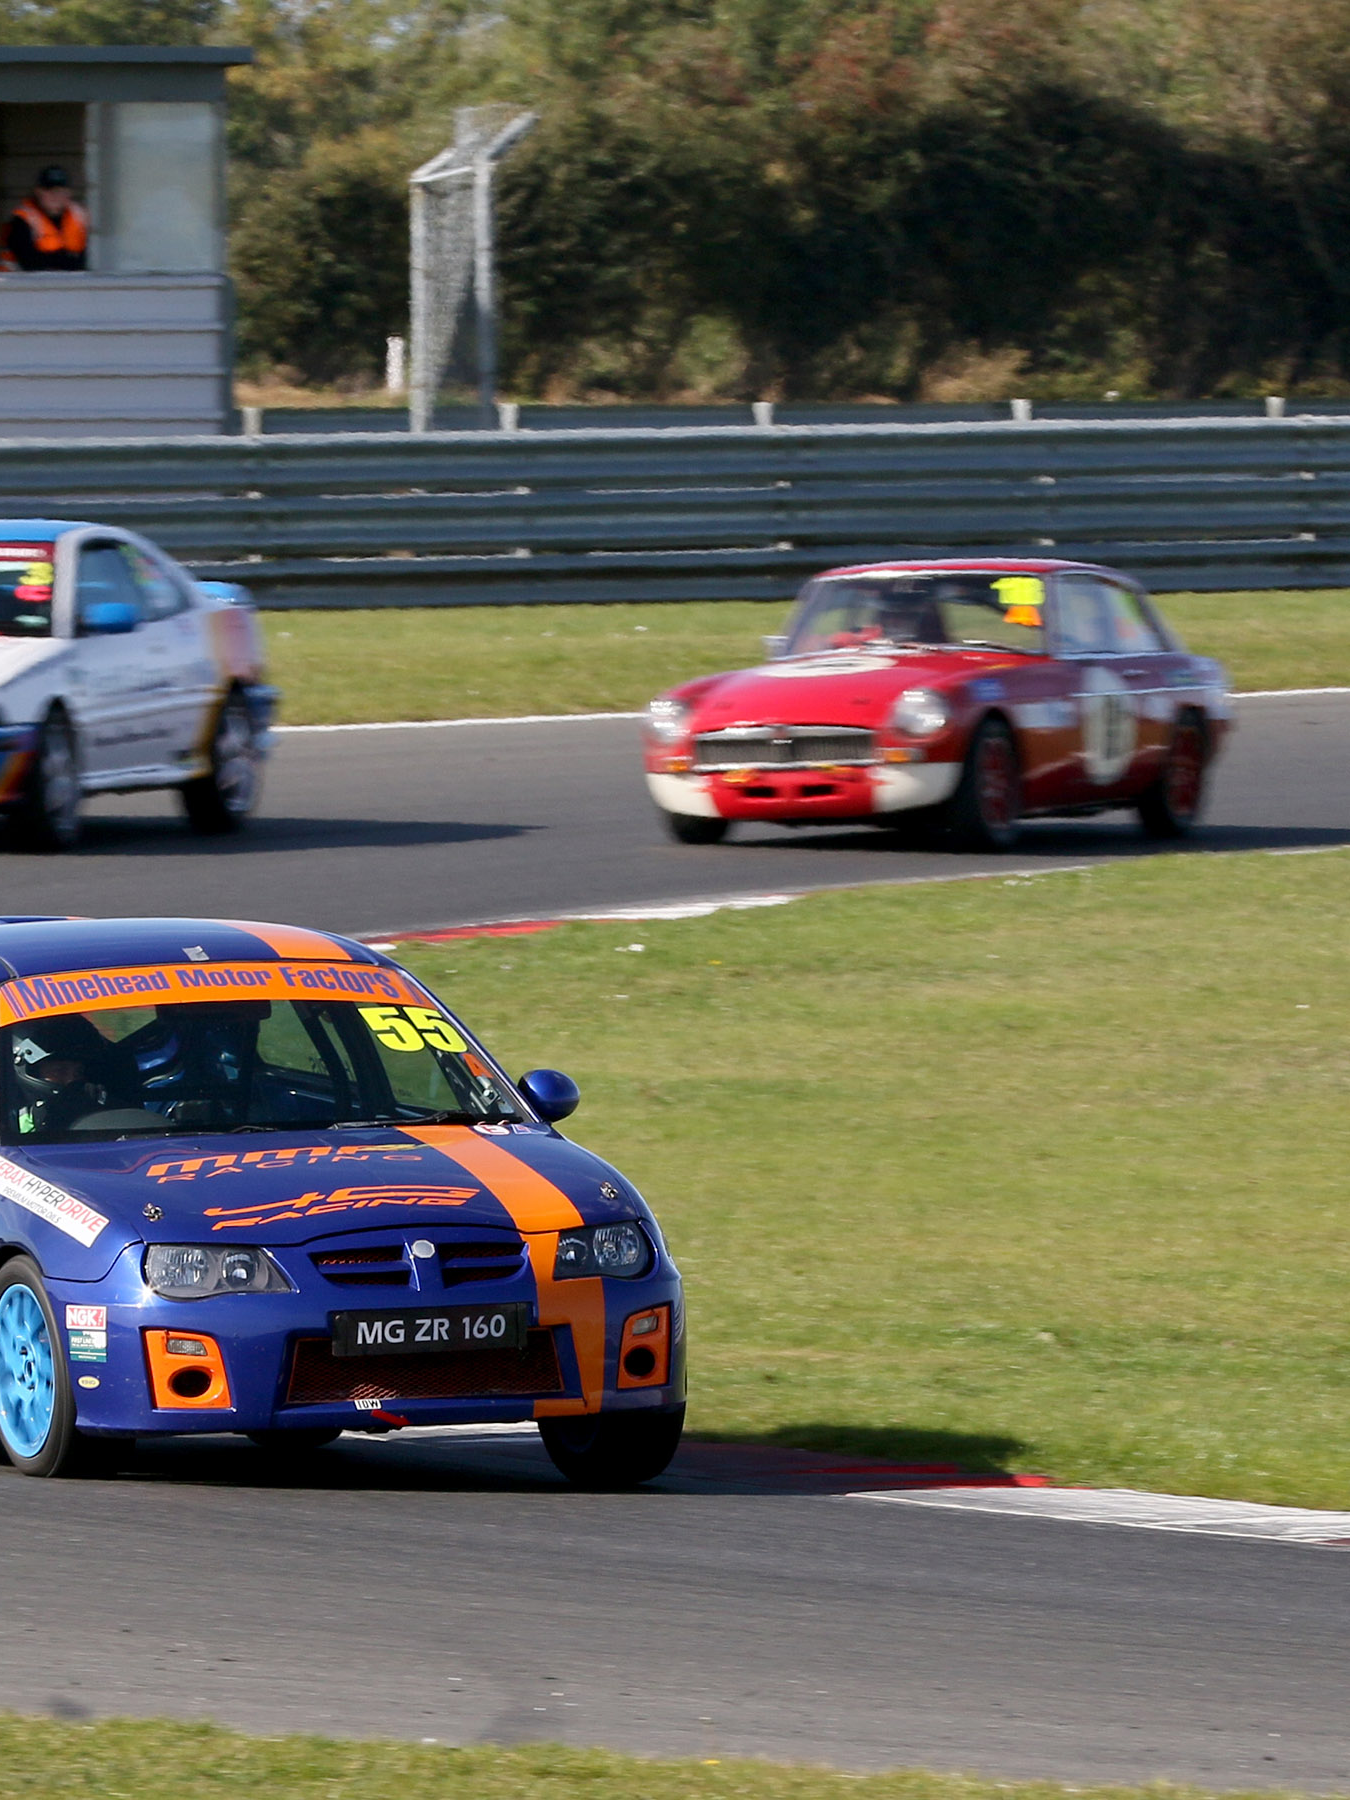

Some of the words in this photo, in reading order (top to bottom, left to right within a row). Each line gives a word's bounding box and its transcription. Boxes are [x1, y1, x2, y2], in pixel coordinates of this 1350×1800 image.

[13, 971, 171, 1014] Minehead
[175, 967, 272, 988] Motor
[279, 966, 400, 999] Factors
[357, 1006, 468, 1053] 55
[157, 1154, 423, 1184] RACING
[211, 1198, 468, 1231] RACING
[68, 1307, 98, 1327] NGK
[356, 1319, 405, 1345] MG
[414, 1317, 450, 1342] ZR
[461, 1313, 507, 1340] 160
